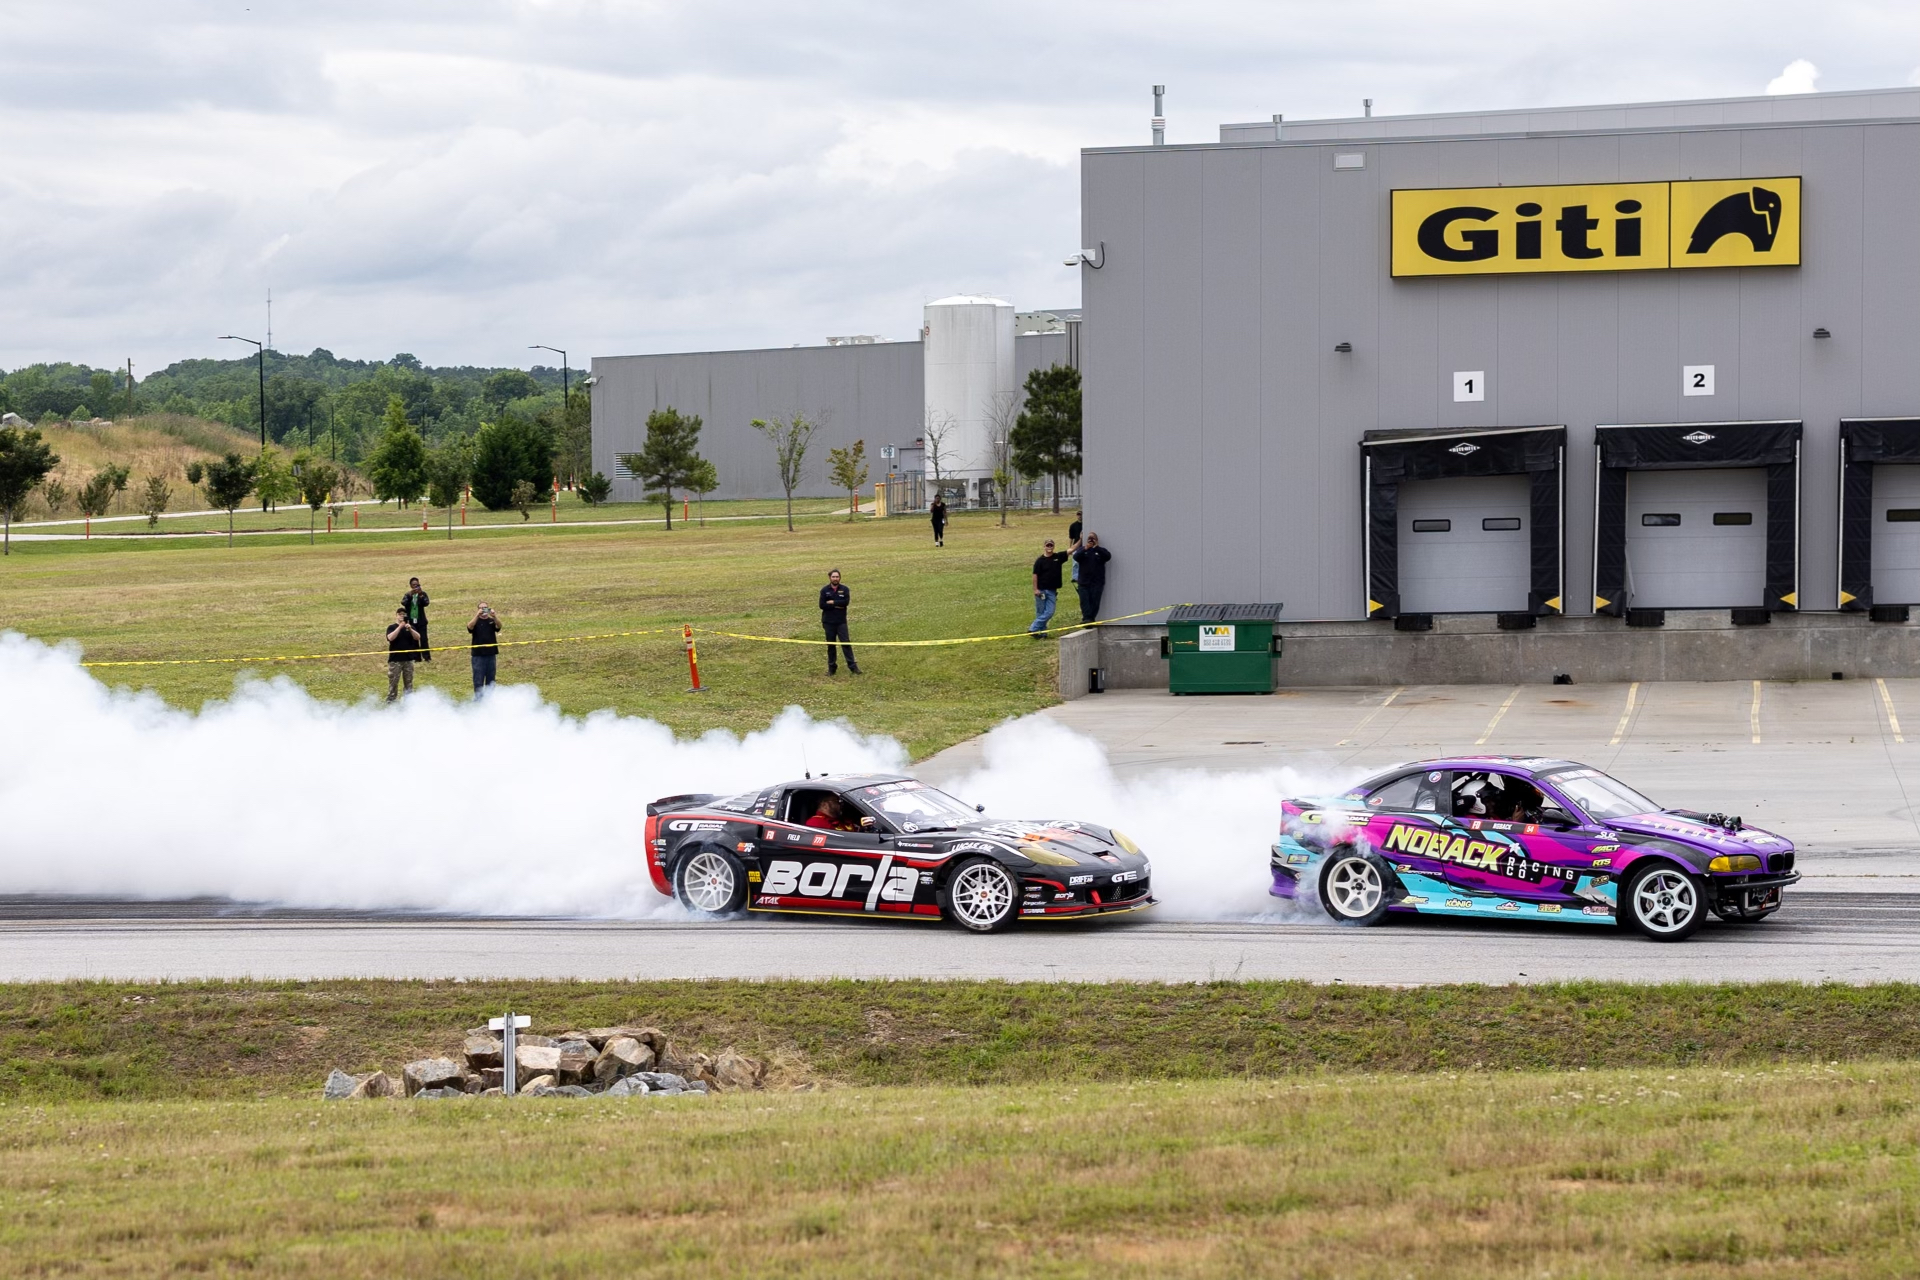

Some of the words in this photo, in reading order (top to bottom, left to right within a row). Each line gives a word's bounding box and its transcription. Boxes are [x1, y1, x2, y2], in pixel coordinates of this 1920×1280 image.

[1417, 199, 1642, 263] Giti
[1464, 379, 1474, 394] 1
[1693, 373, 1706, 388] 2
[1203, 626, 1230, 635] WM
[669, 820, 702, 831] GT
[1526, 825, 1535, 833] 54
[787, 833, 800, 842] FIELD
[951, 842, 979, 852] LUCAS
[1386, 825, 1508, 872] NOBACK
[1506, 856, 1574, 880] RACING
[1506, 866, 1534, 881] CO.
